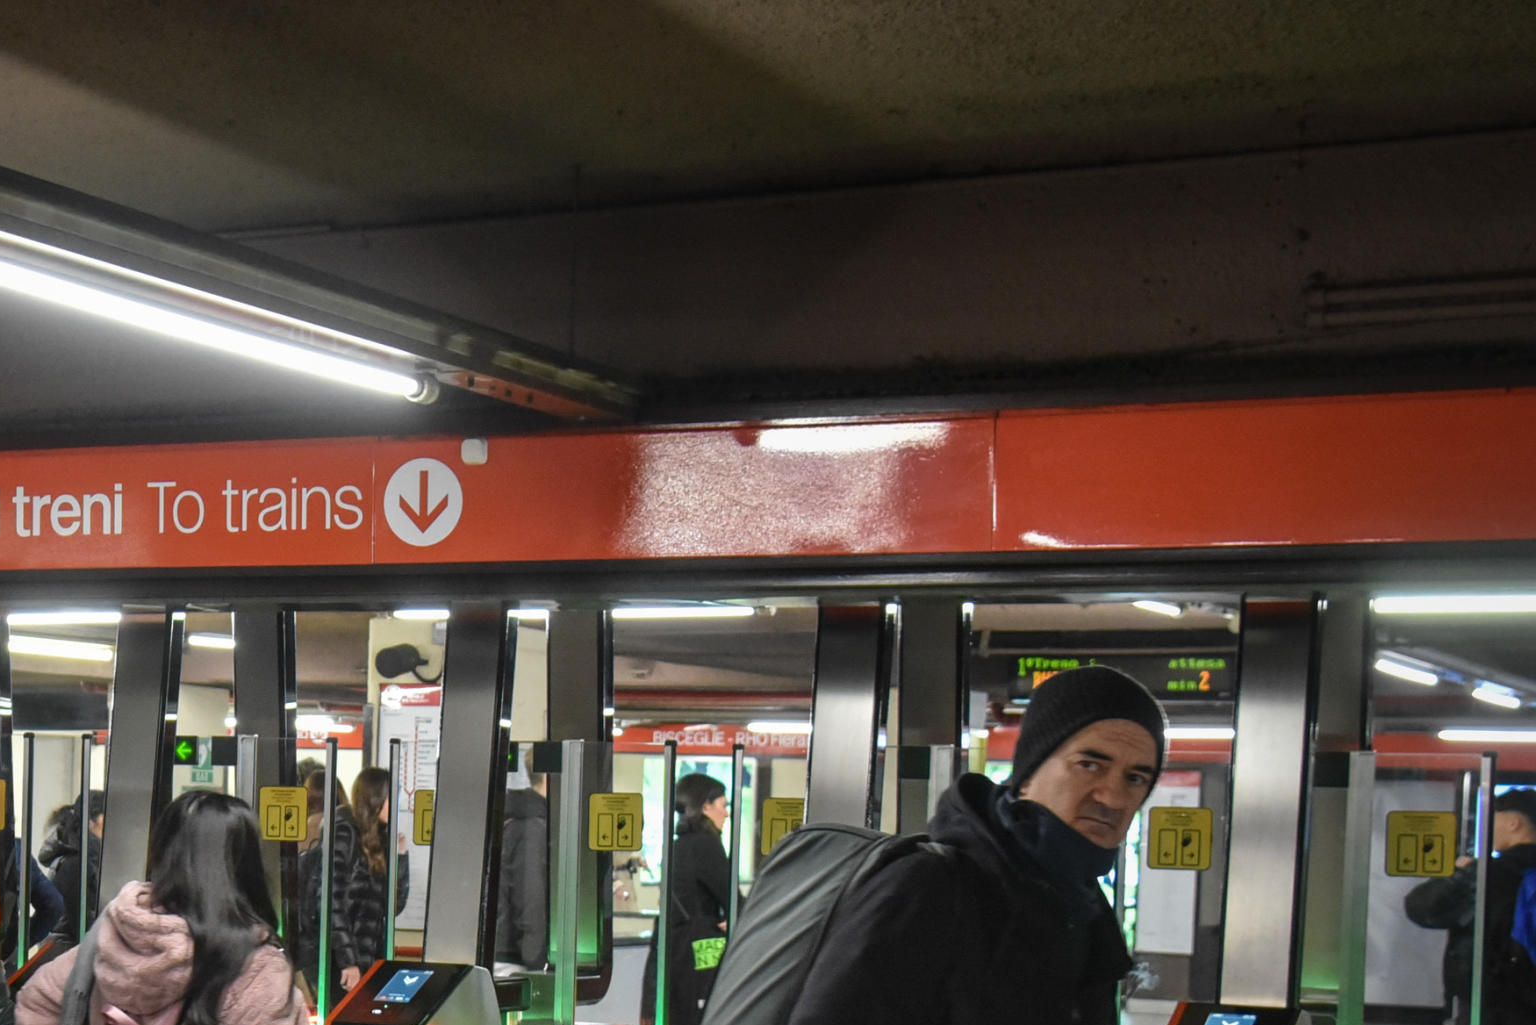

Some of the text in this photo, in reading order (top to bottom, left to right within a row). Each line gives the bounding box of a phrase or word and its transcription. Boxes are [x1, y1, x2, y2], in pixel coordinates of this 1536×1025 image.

[12, 483, 123, 537] treni
[147, 480, 205, 534] To
[222, 477, 364, 533] trains
[1167, 670, 1212, 692] min 2
[735, 731, 771, 746] RHO
